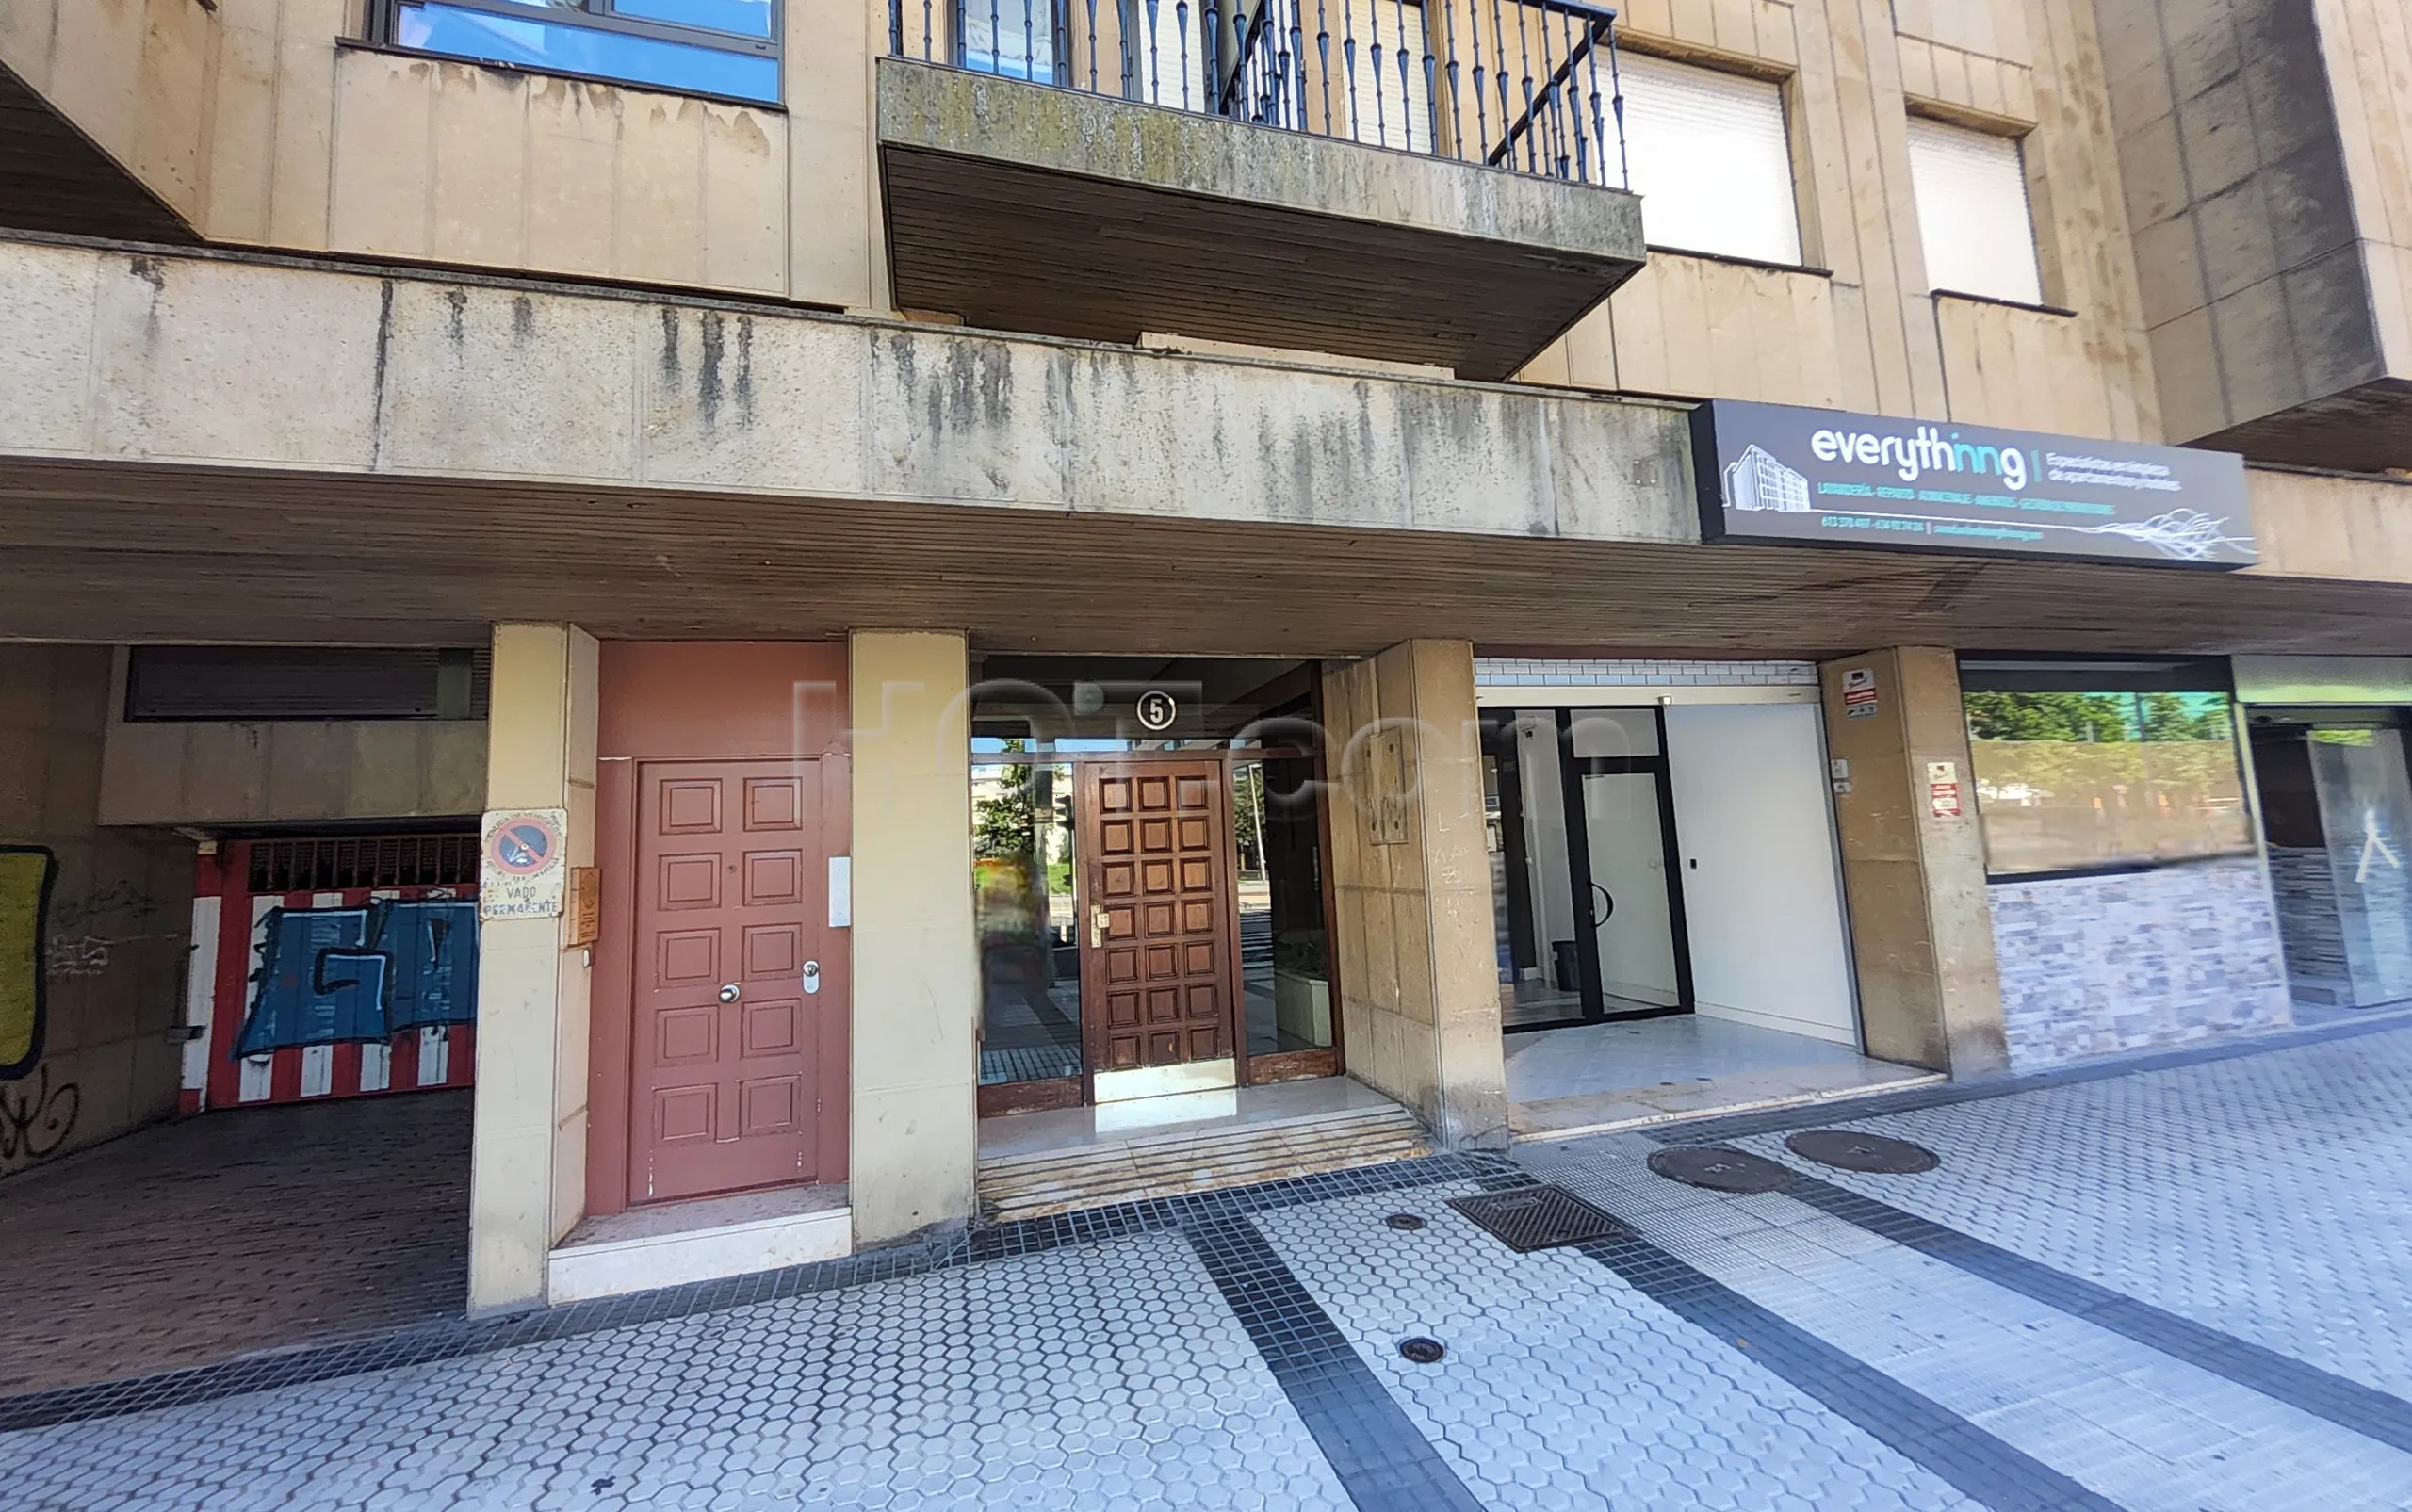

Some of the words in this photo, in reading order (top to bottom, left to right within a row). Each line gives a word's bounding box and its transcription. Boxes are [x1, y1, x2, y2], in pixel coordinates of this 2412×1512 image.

[1811, 426, 2027, 491] everythinng
[1150, 698, 1164, 723] 5
[506, 886, 536, 899] VADO
